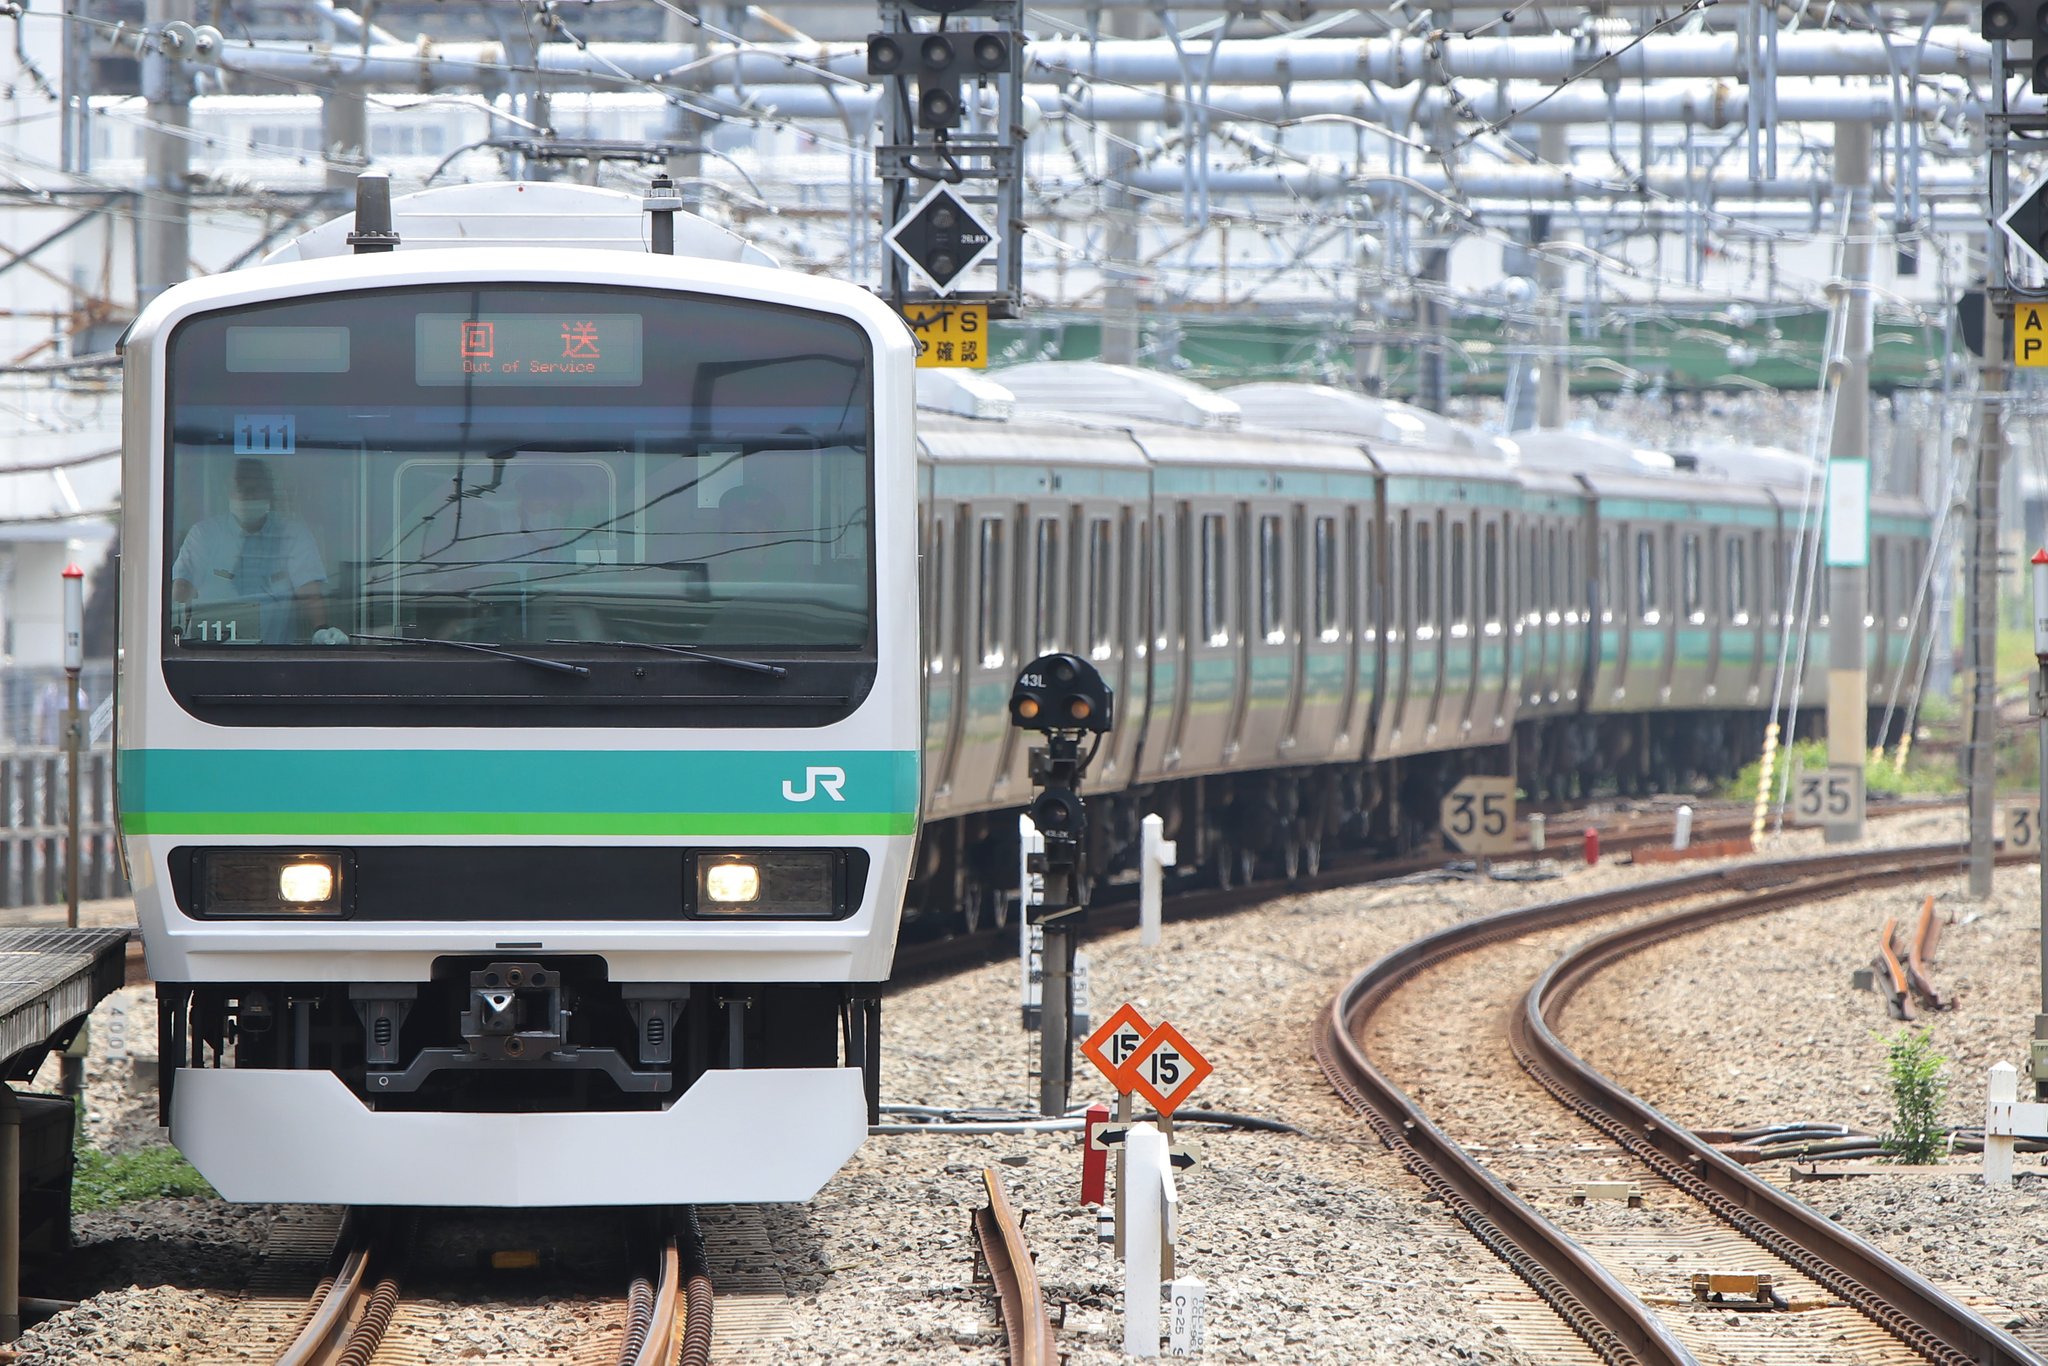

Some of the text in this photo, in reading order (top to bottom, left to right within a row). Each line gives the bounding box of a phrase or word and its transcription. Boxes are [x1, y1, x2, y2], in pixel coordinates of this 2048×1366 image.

[2024, 309, 2043, 330] A
[461, 320, 600, 358] 回送
[2024, 338, 2043, 360] P
[463, 360, 596, 373] Out of Service
[241, 424, 289, 450] 111
[197, 620, 236, 641] 111
[1020, 673, 1047, 688] 43L
[782, 766, 846, 802] JR
[1802, 777, 1851, 815] 35
[1453, 793, 1506, 835] 35
[2013, 807, 2041, 847] 3
[1113, 1034, 1139, 1064] 15
[1152, 1053, 1179, 1084] 15
[1174, 1295, 1186, 1335] C=25
